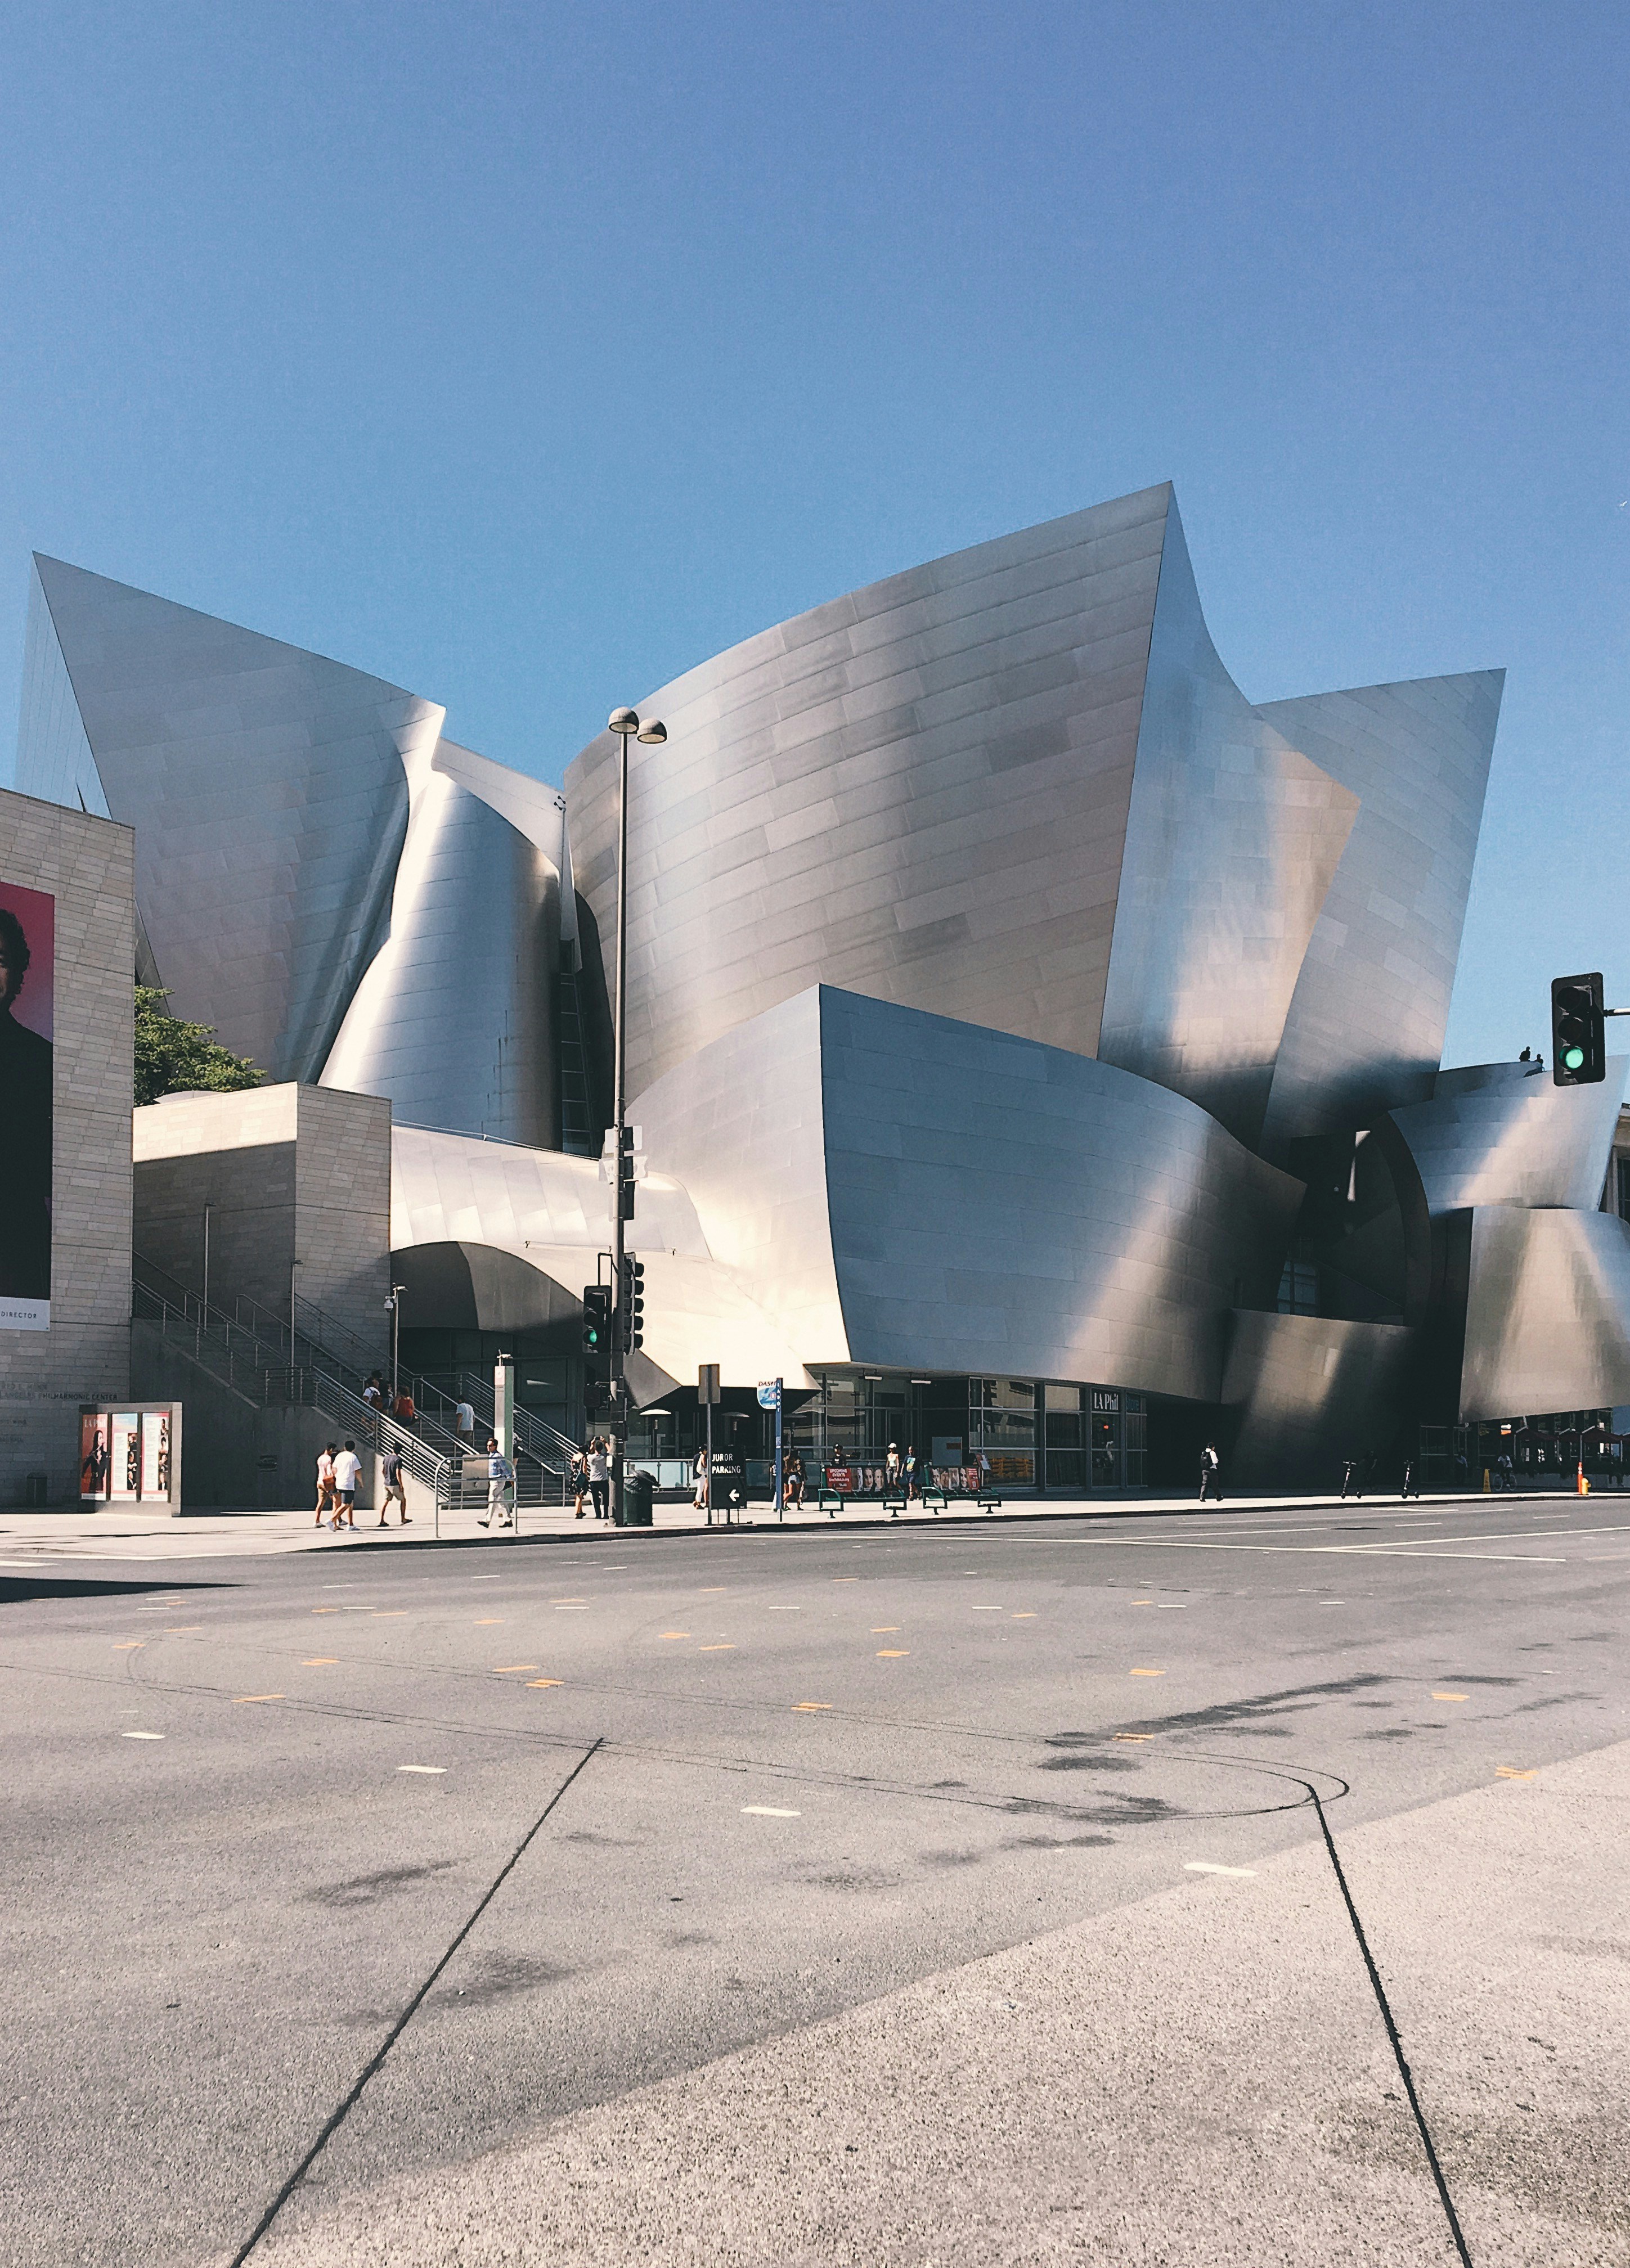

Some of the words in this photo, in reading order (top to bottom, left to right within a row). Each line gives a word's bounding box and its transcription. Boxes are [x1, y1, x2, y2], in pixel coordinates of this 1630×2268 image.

[1094, 1392, 1103, 1410] LA
[1104, 1393, 1119, 1410] Phil
[711, 1454, 733, 1462] JUROR
[711, 1465, 741, 1474] PARKING
